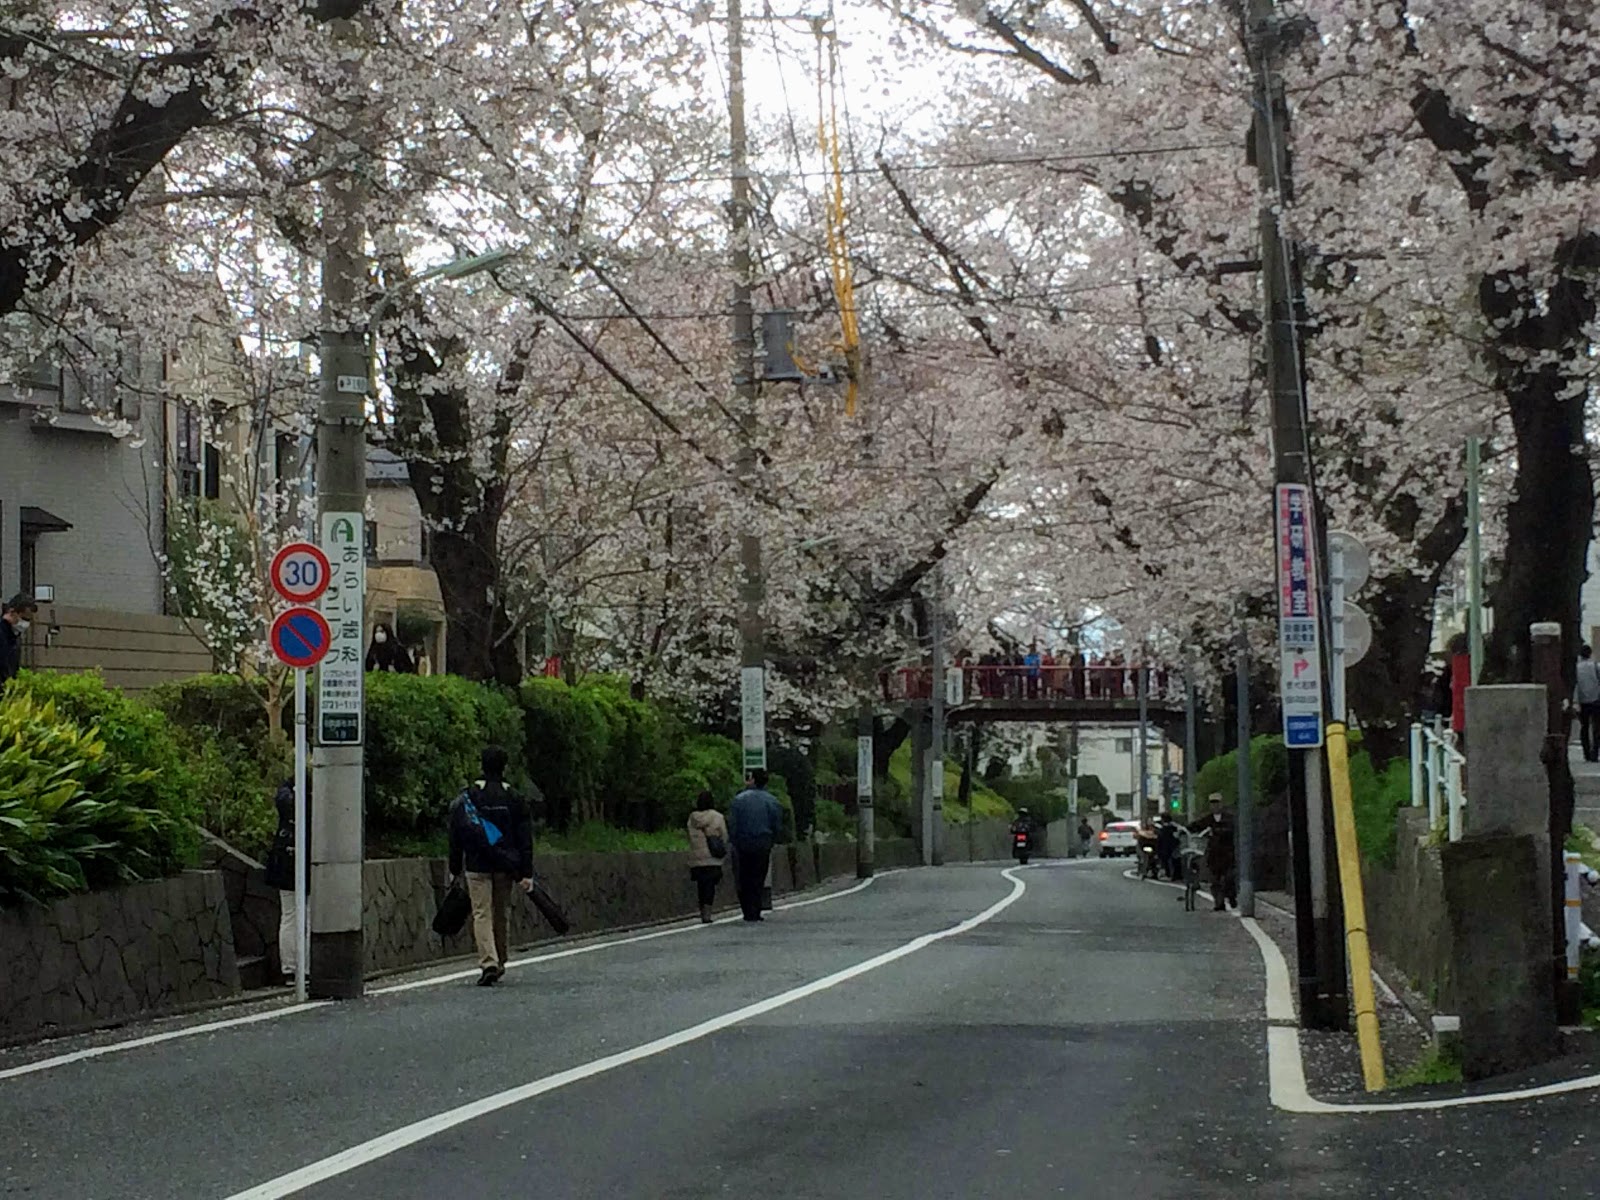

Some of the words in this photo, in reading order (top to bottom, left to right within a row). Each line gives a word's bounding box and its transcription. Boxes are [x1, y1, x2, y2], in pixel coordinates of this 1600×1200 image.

[284, 560, 318, 586] 30
[341, 546, 359, 665] あらい歯科
